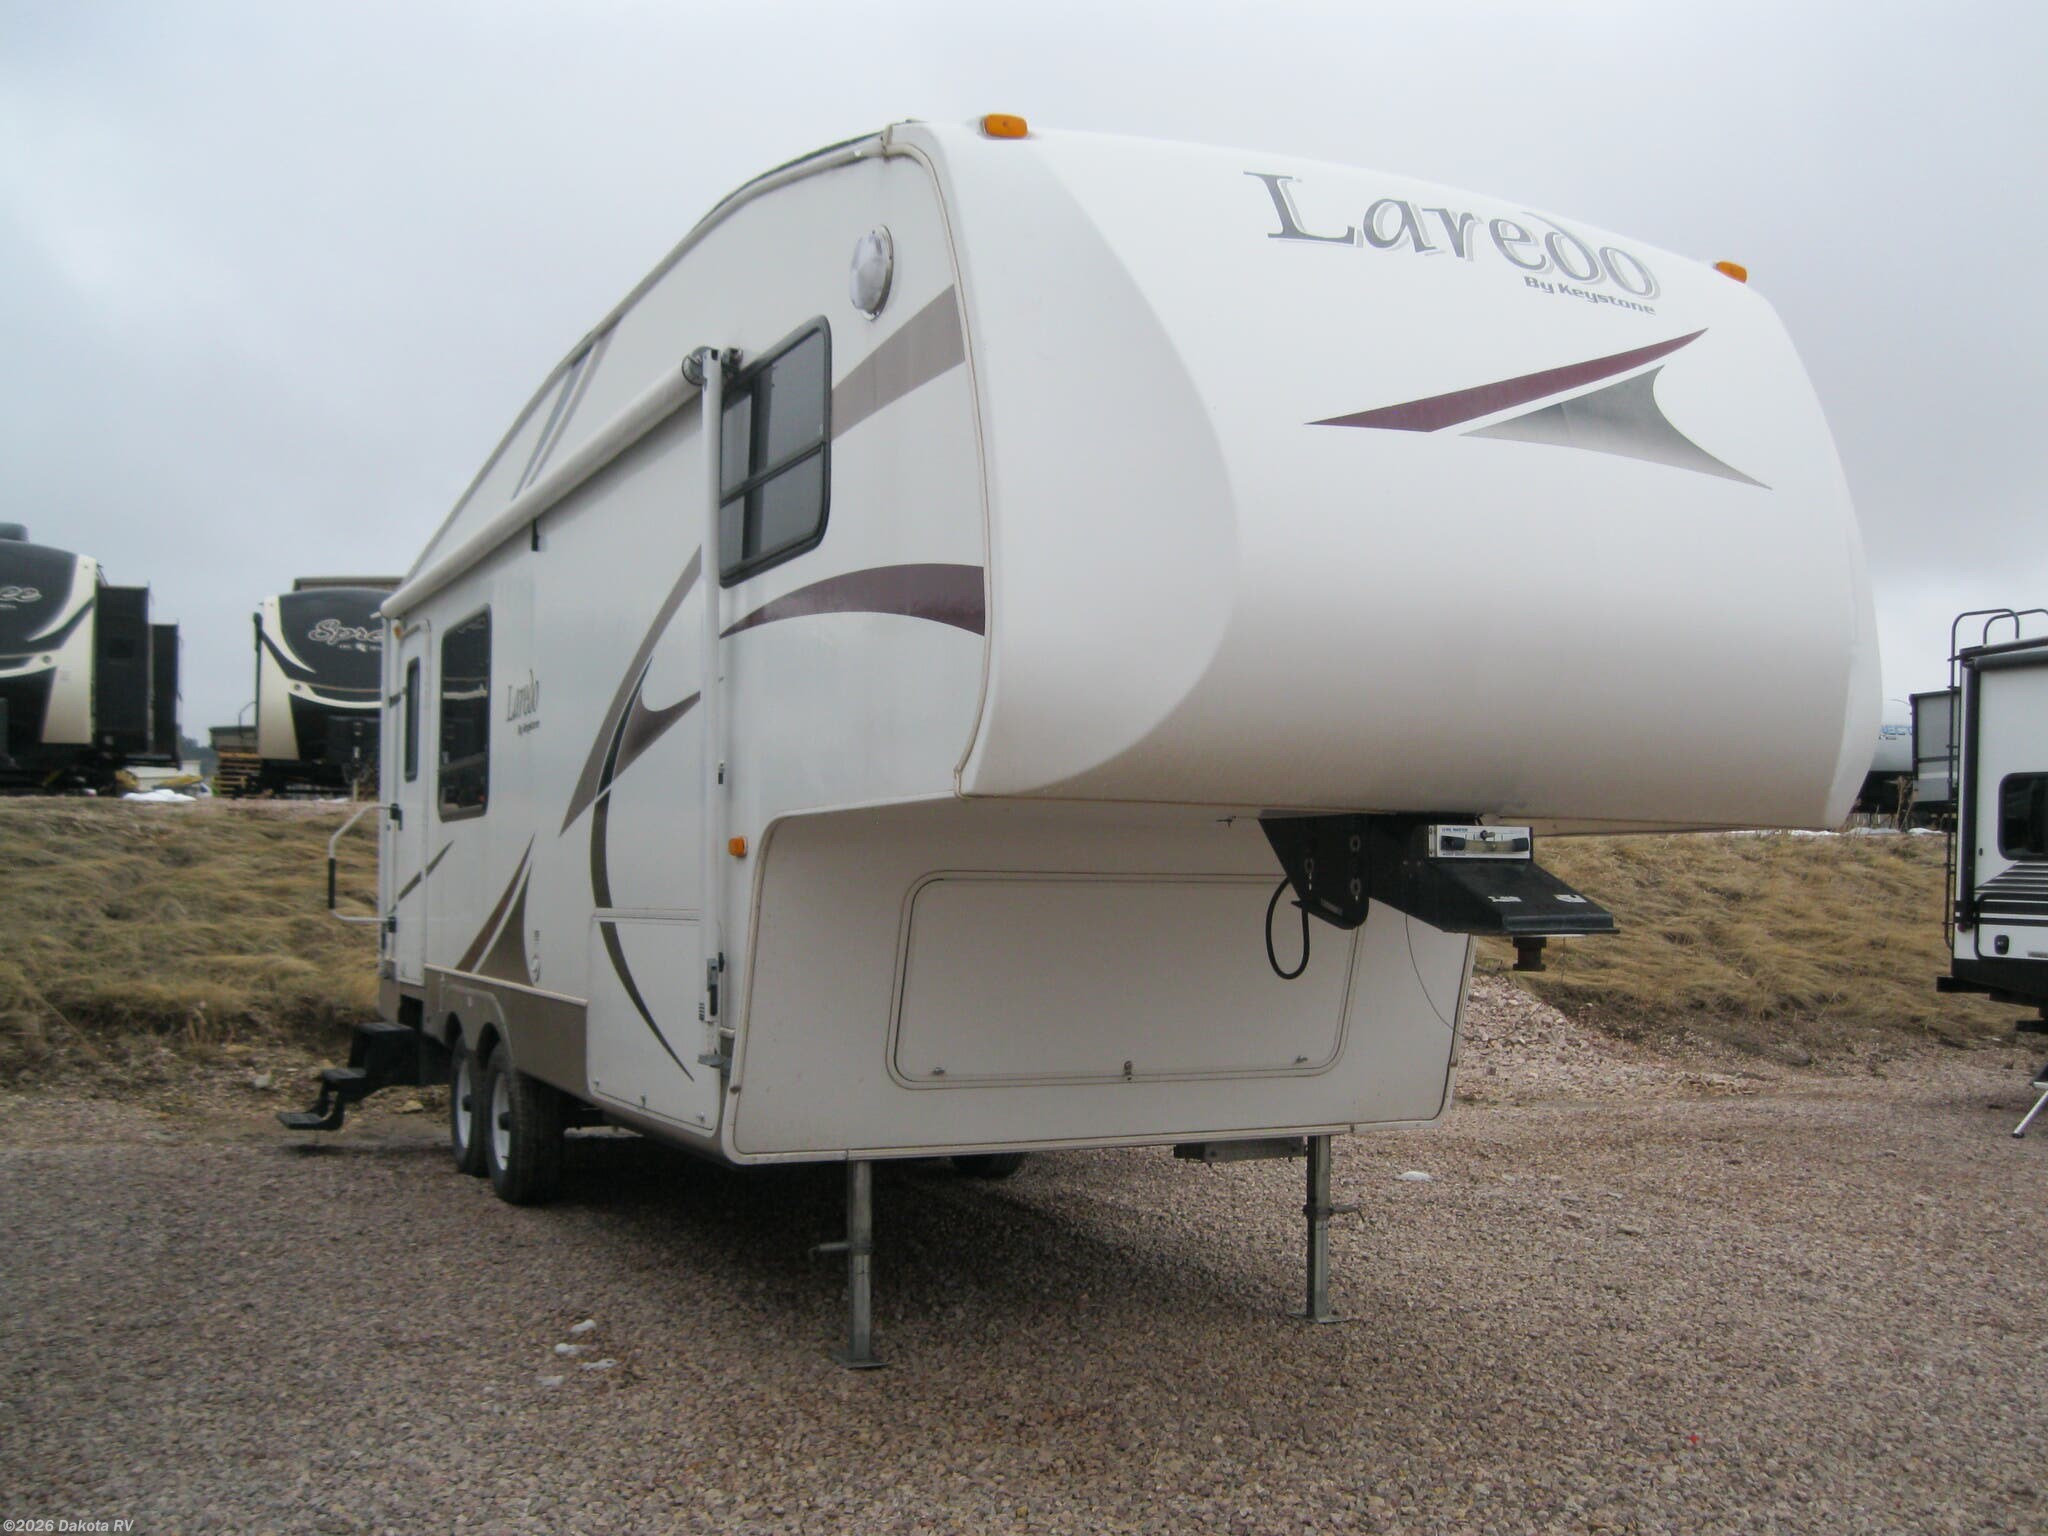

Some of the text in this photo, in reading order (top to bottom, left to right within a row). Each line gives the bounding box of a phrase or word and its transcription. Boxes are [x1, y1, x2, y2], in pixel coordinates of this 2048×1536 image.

[1243, 171, 1660, 299] Laredo
[1524, 276, 1657, 316] By Keystone
